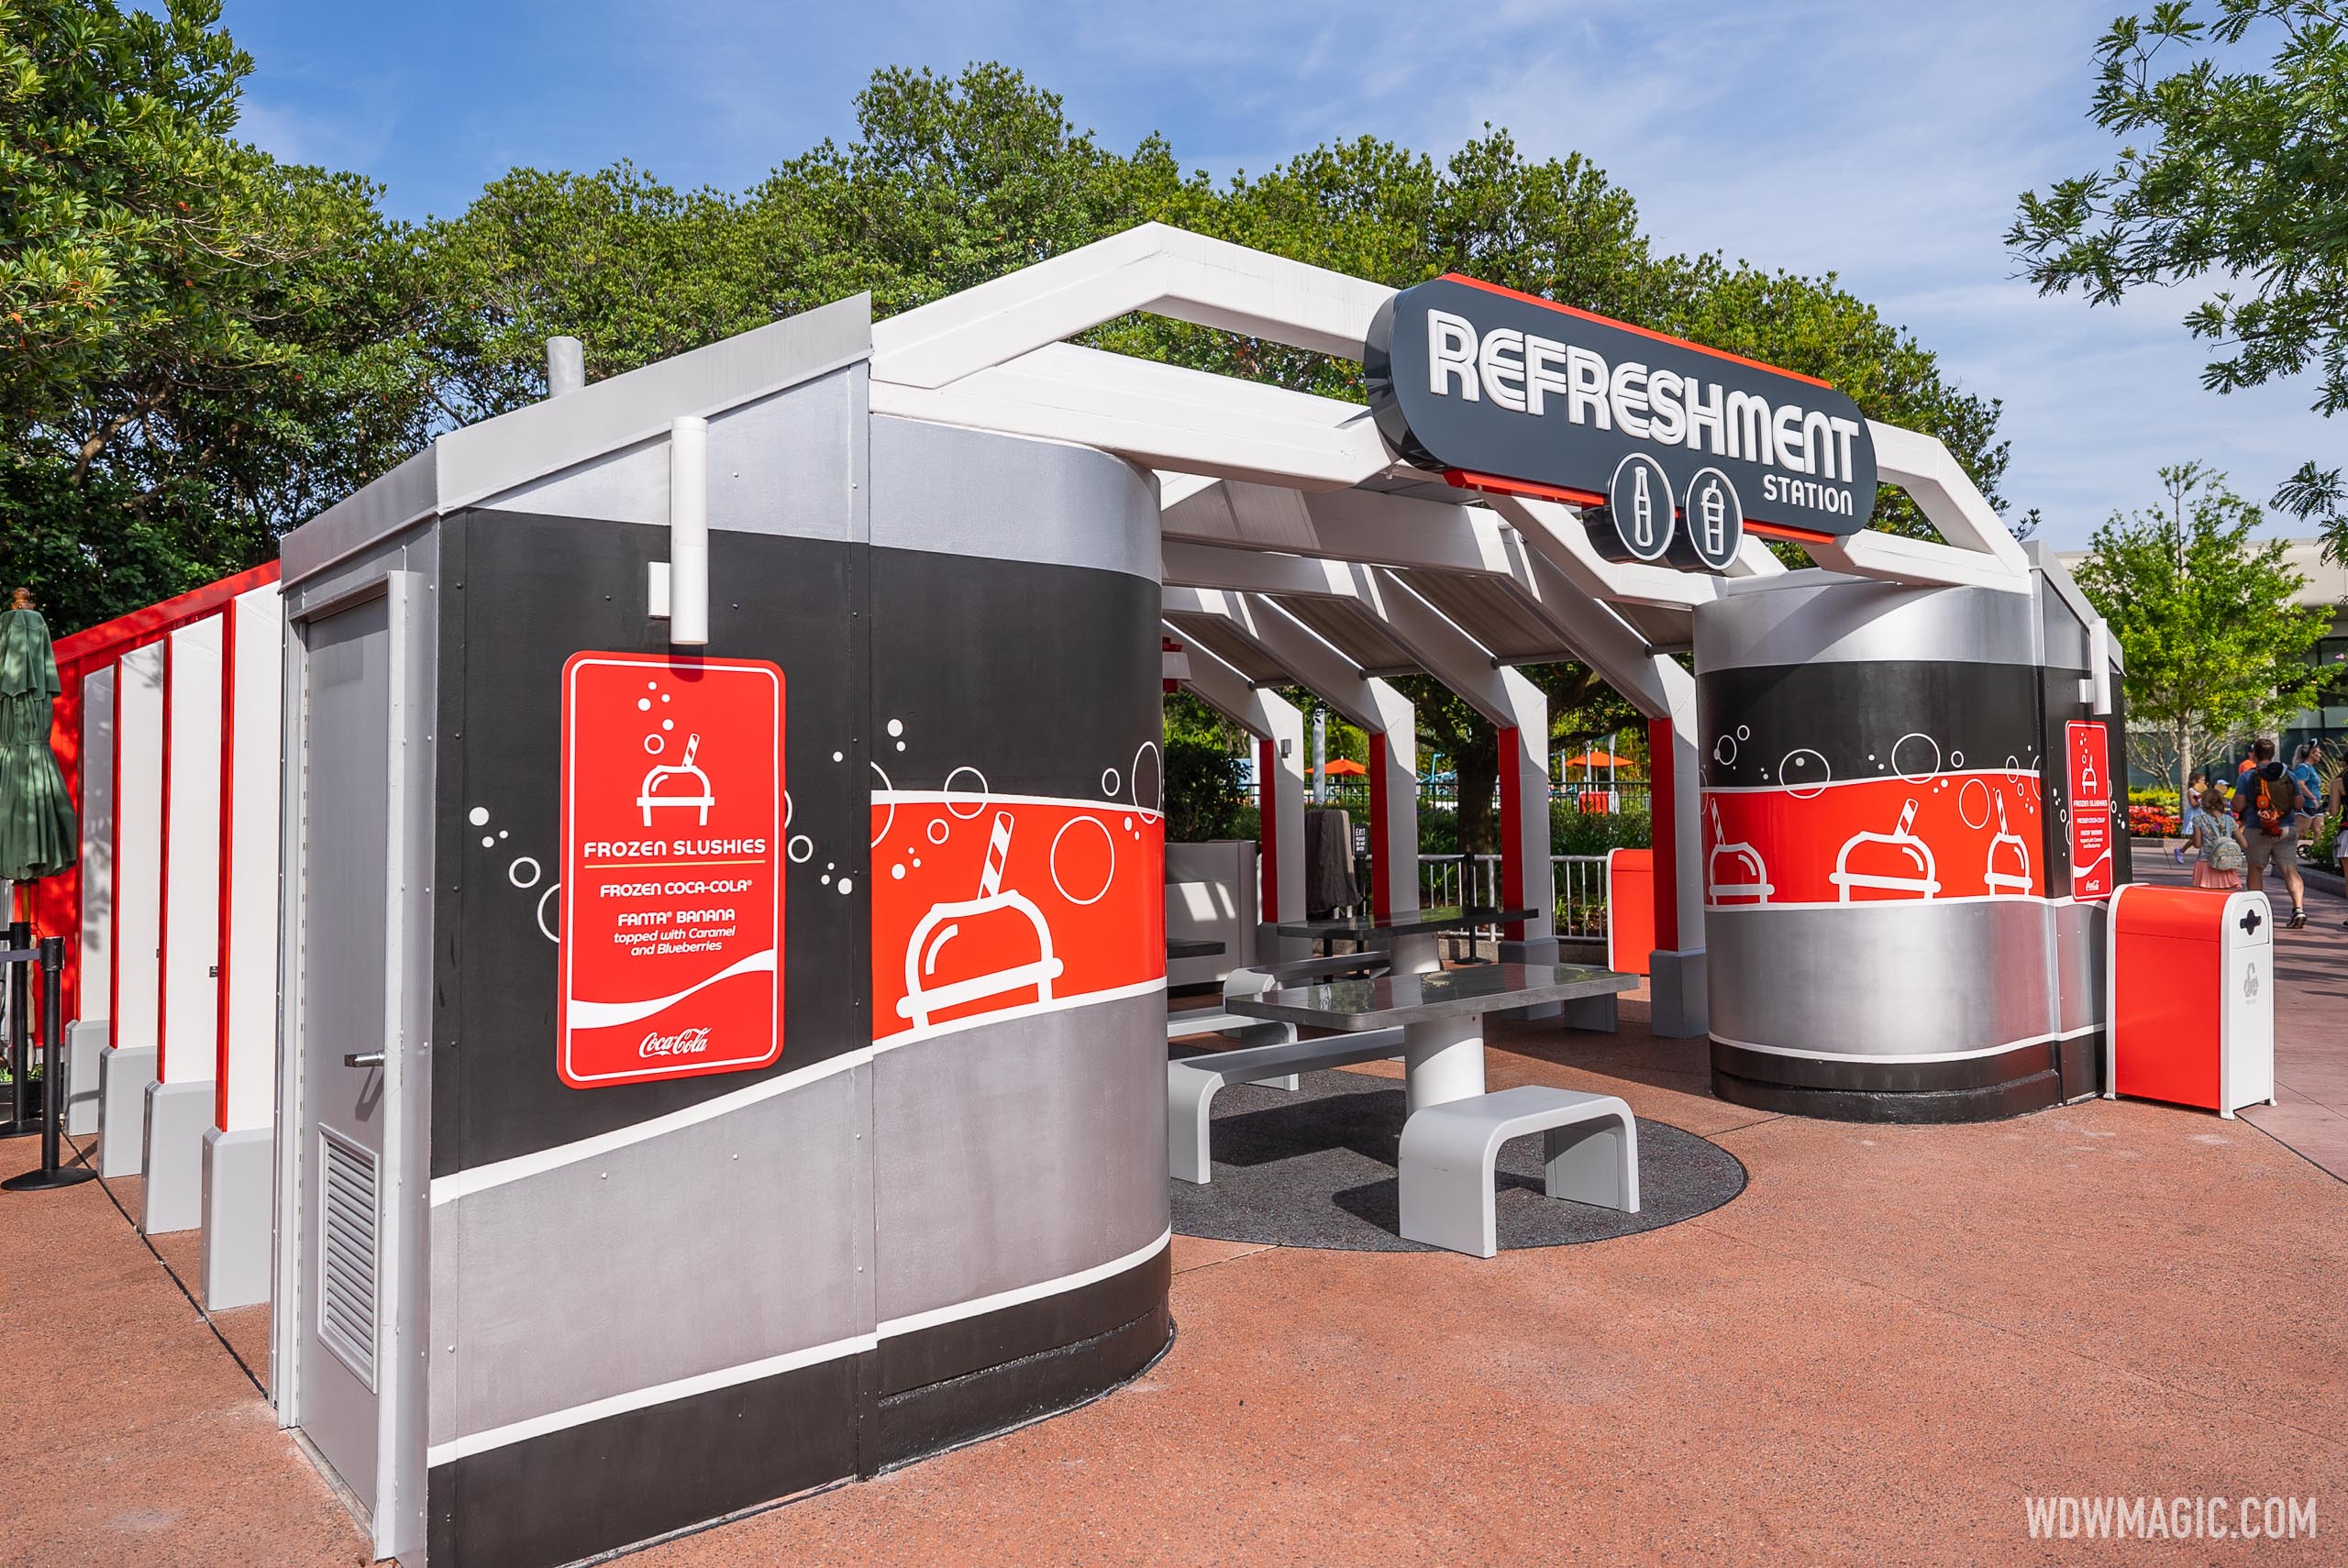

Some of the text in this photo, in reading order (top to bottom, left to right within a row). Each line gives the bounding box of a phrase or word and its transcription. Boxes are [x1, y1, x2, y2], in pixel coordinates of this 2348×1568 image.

[1427, 308, 1860, 483] REFRESHMENT
[1763, 473, 1854, 516] STATION
[583, 838, 767, 858] FROZEN SLUSHIES
[600, 882, 662, 898] FROZEN
[676, 908, 736, 924] BANANA
[614, 924, 737, 945] topped with Caramel
[630, 940, 723, 956] and Blueberries
[638, 1026, 713, 1058] Coca-Cola
